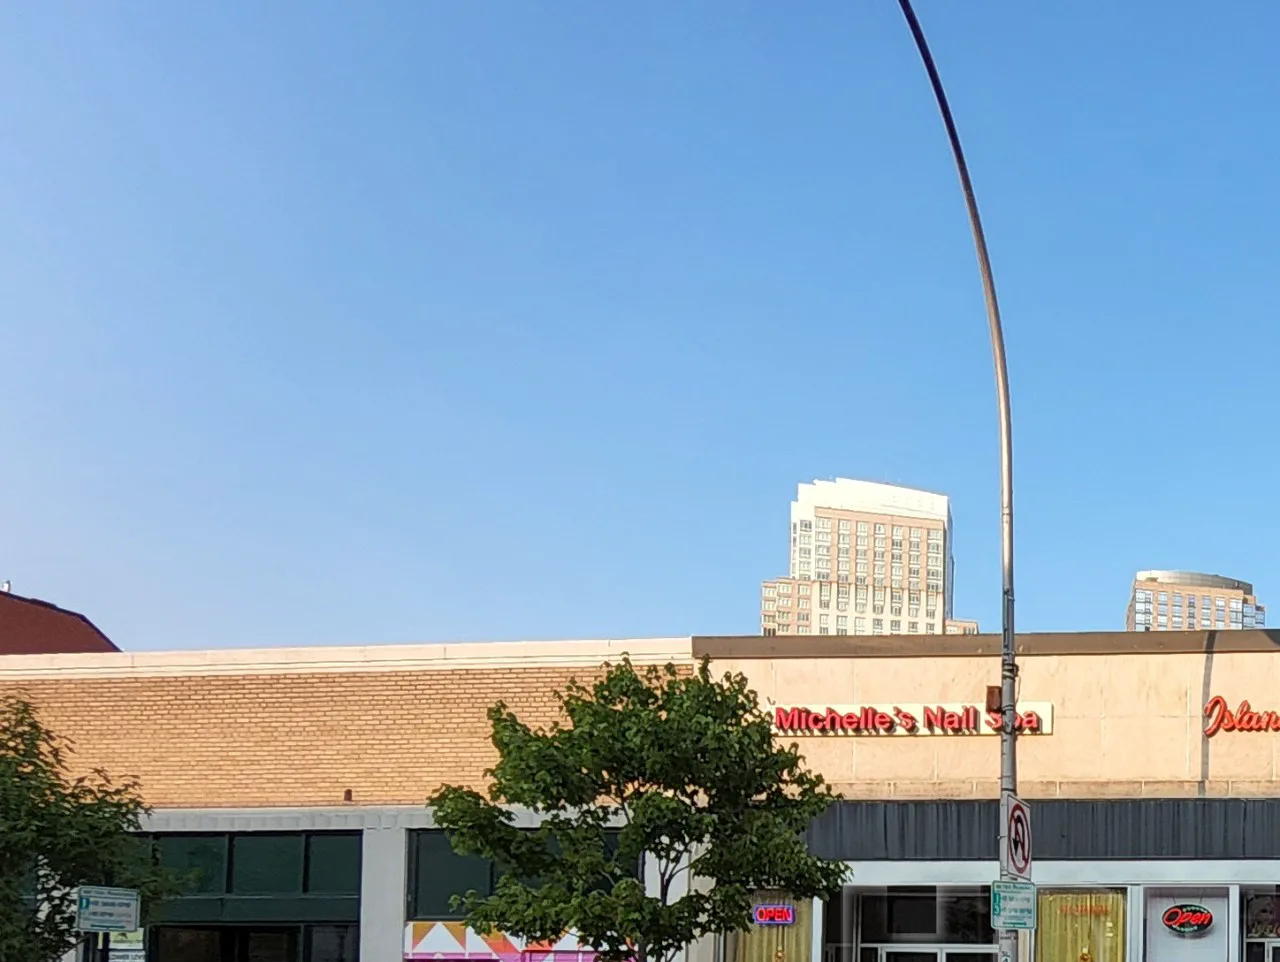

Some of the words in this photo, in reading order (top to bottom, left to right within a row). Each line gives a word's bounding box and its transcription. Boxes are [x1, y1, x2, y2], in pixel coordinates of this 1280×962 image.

[775, 706, 918, 731] Michelle's
[923, 705, 979, 731] Nail
[757, 908, 792, 921] OPEN
[1163, 907, 1212, 927] Open
